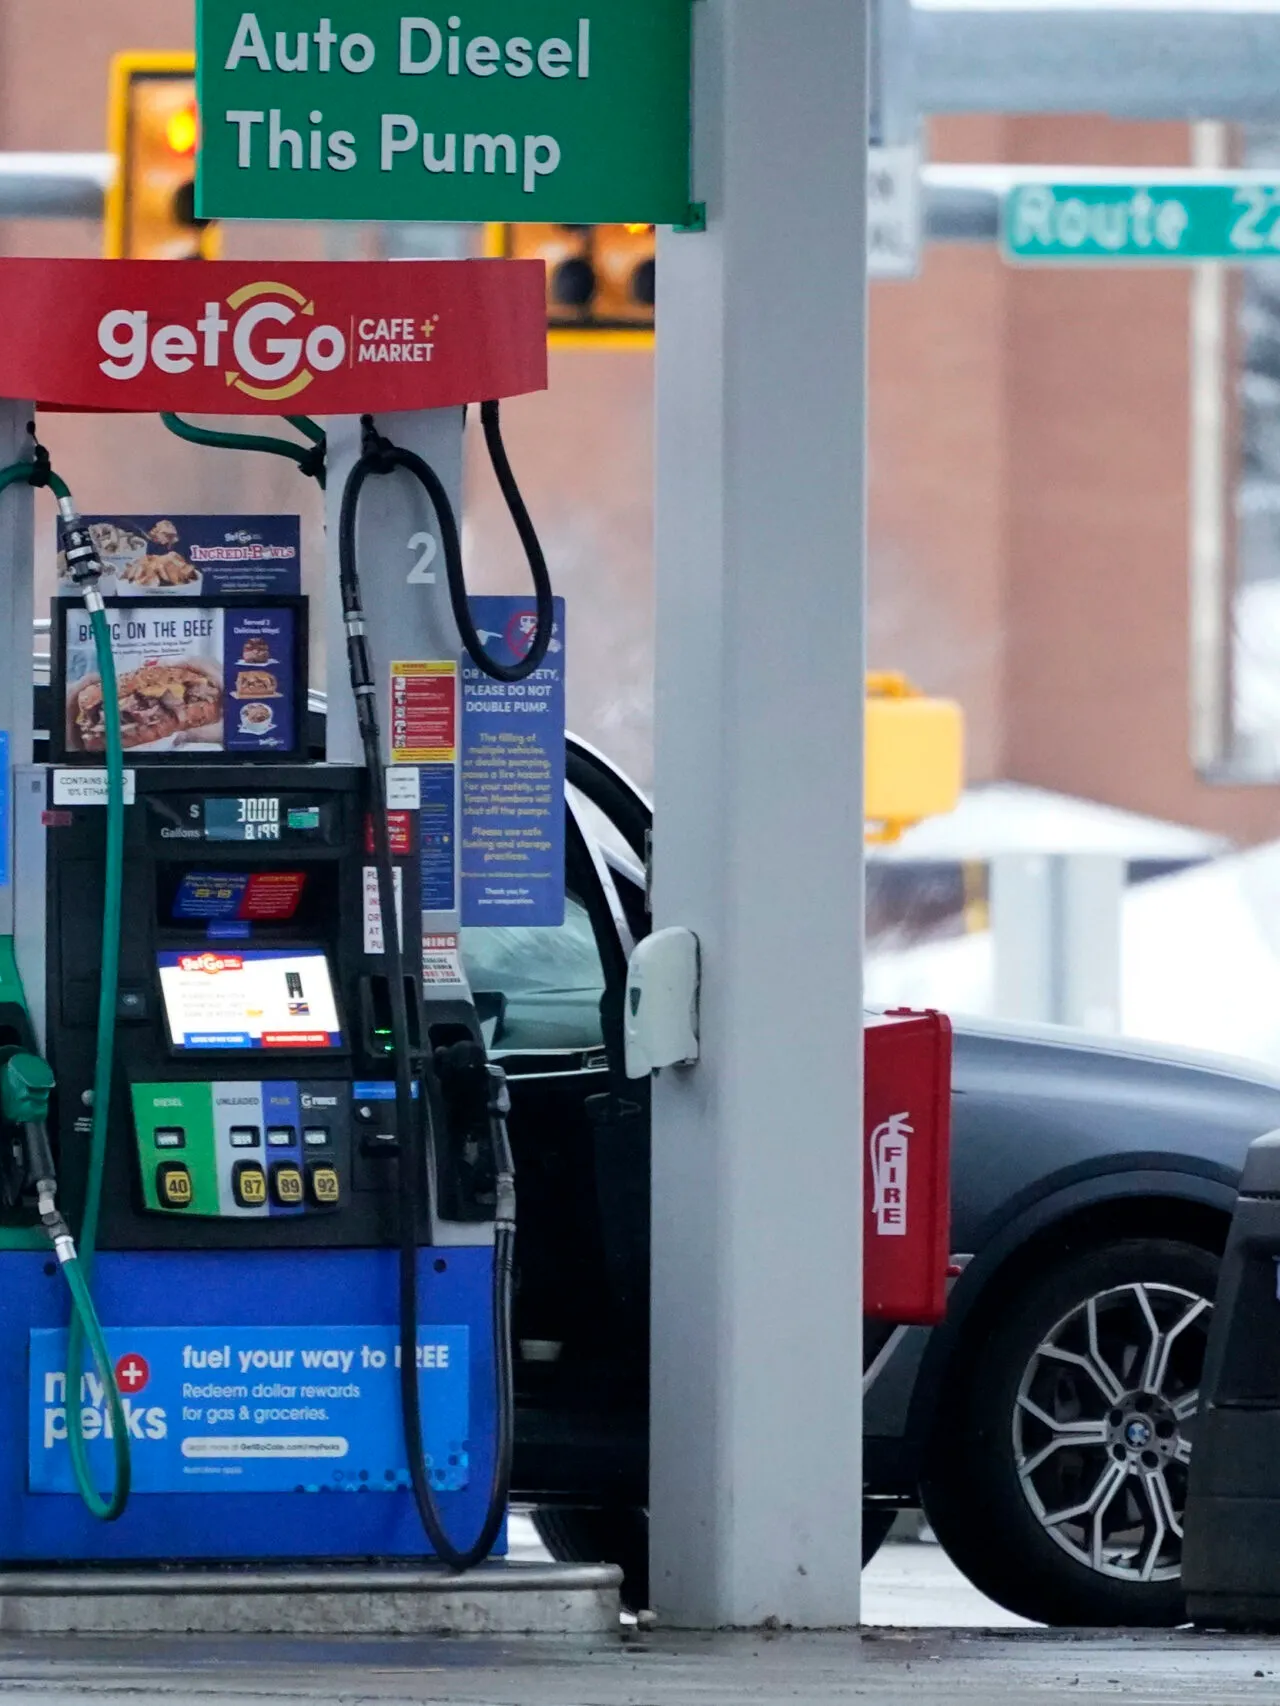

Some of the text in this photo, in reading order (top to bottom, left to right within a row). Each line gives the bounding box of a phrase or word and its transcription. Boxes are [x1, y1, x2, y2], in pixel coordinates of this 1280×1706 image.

[224, 13, 590, 79] Auto Diesel
[225, 109, 561, 193] This Pump
[1014, 185, 1188, 250] Route
[97, 302, 346, 381] getGo
[358, 319, 415, 341] CAFE
[358, 343, 435, 363] MARKET
[406, 532, 437, 584] 2
[127, 621, 145, 639] ON
[154, 620, 177, 638] THE
[183, 619, 214, 637] BEEF
[464, 685, 552, 696] PLEASE DO NOT
[466, 701, 549, 713] DOUBLE PUMP.
[60, 777, 102, 785] CONTAINS
[189, 804, 200, 818] $
[160, 827, 200, 838] Gallons
[152, 1097, 184, 1107] DIESEL
[215, 1097, 260, 1106] UNLEADED
[170, 1180, 188, 1193] 40
[244, 1180, 262, 1194] 87
[281, 1180, 299, 1193] 89
[317, 1179, 336, 1192] 92
[882, 1146, 902, 1224] FIRE
[182, 1345, 231, 1369] fuel
[238, 1349, 296, 1373] your
[301, 1349, 354, 1373] way
[361, 1345, 386, 1368] to
[182, 1382, 360, 1399] Redeem dollar rewards
[182, 1406, 329, 1425] for gas & groceries.
